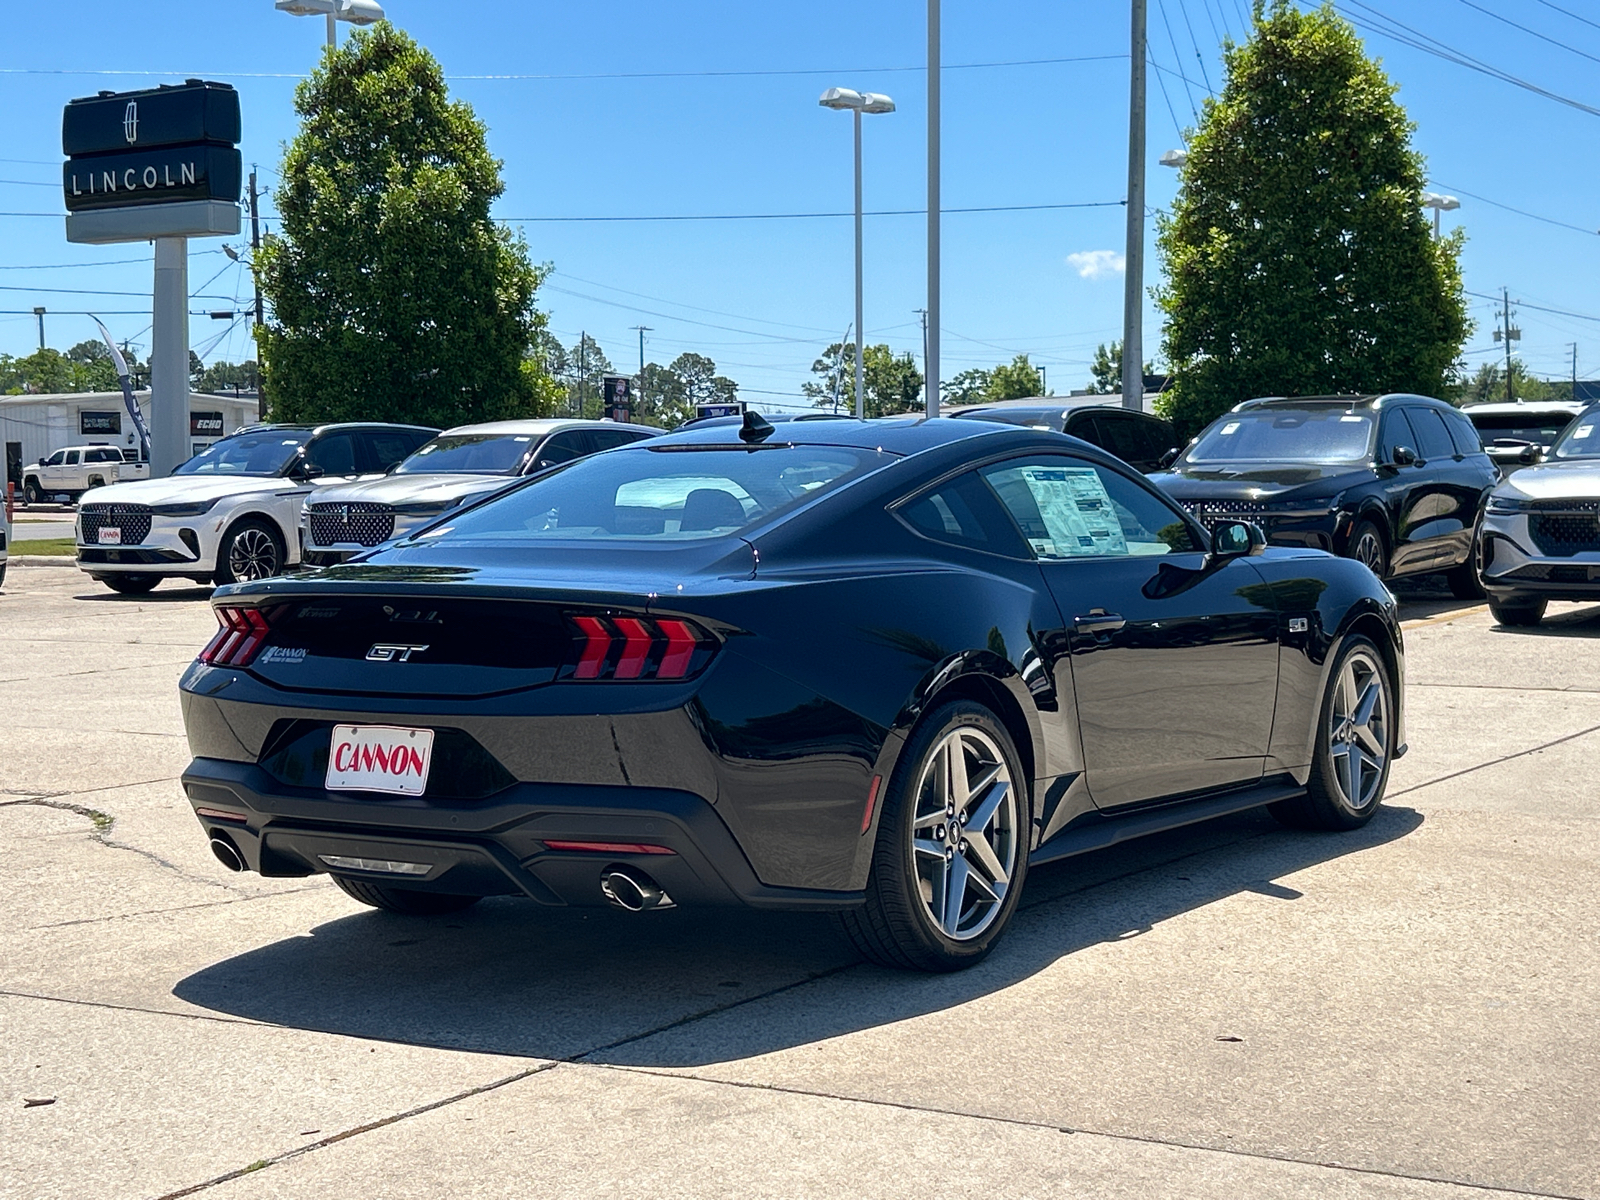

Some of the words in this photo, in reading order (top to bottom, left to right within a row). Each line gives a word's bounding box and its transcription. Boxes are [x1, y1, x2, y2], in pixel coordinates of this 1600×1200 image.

[72, 162, 196, 196] LINCOLN
[196, 419, 222, 429] ECHO
[274, 647, 309, 658] CANNON
[365, 642, 430, 662] GT
[335, 742, 426, 777] CANNON
